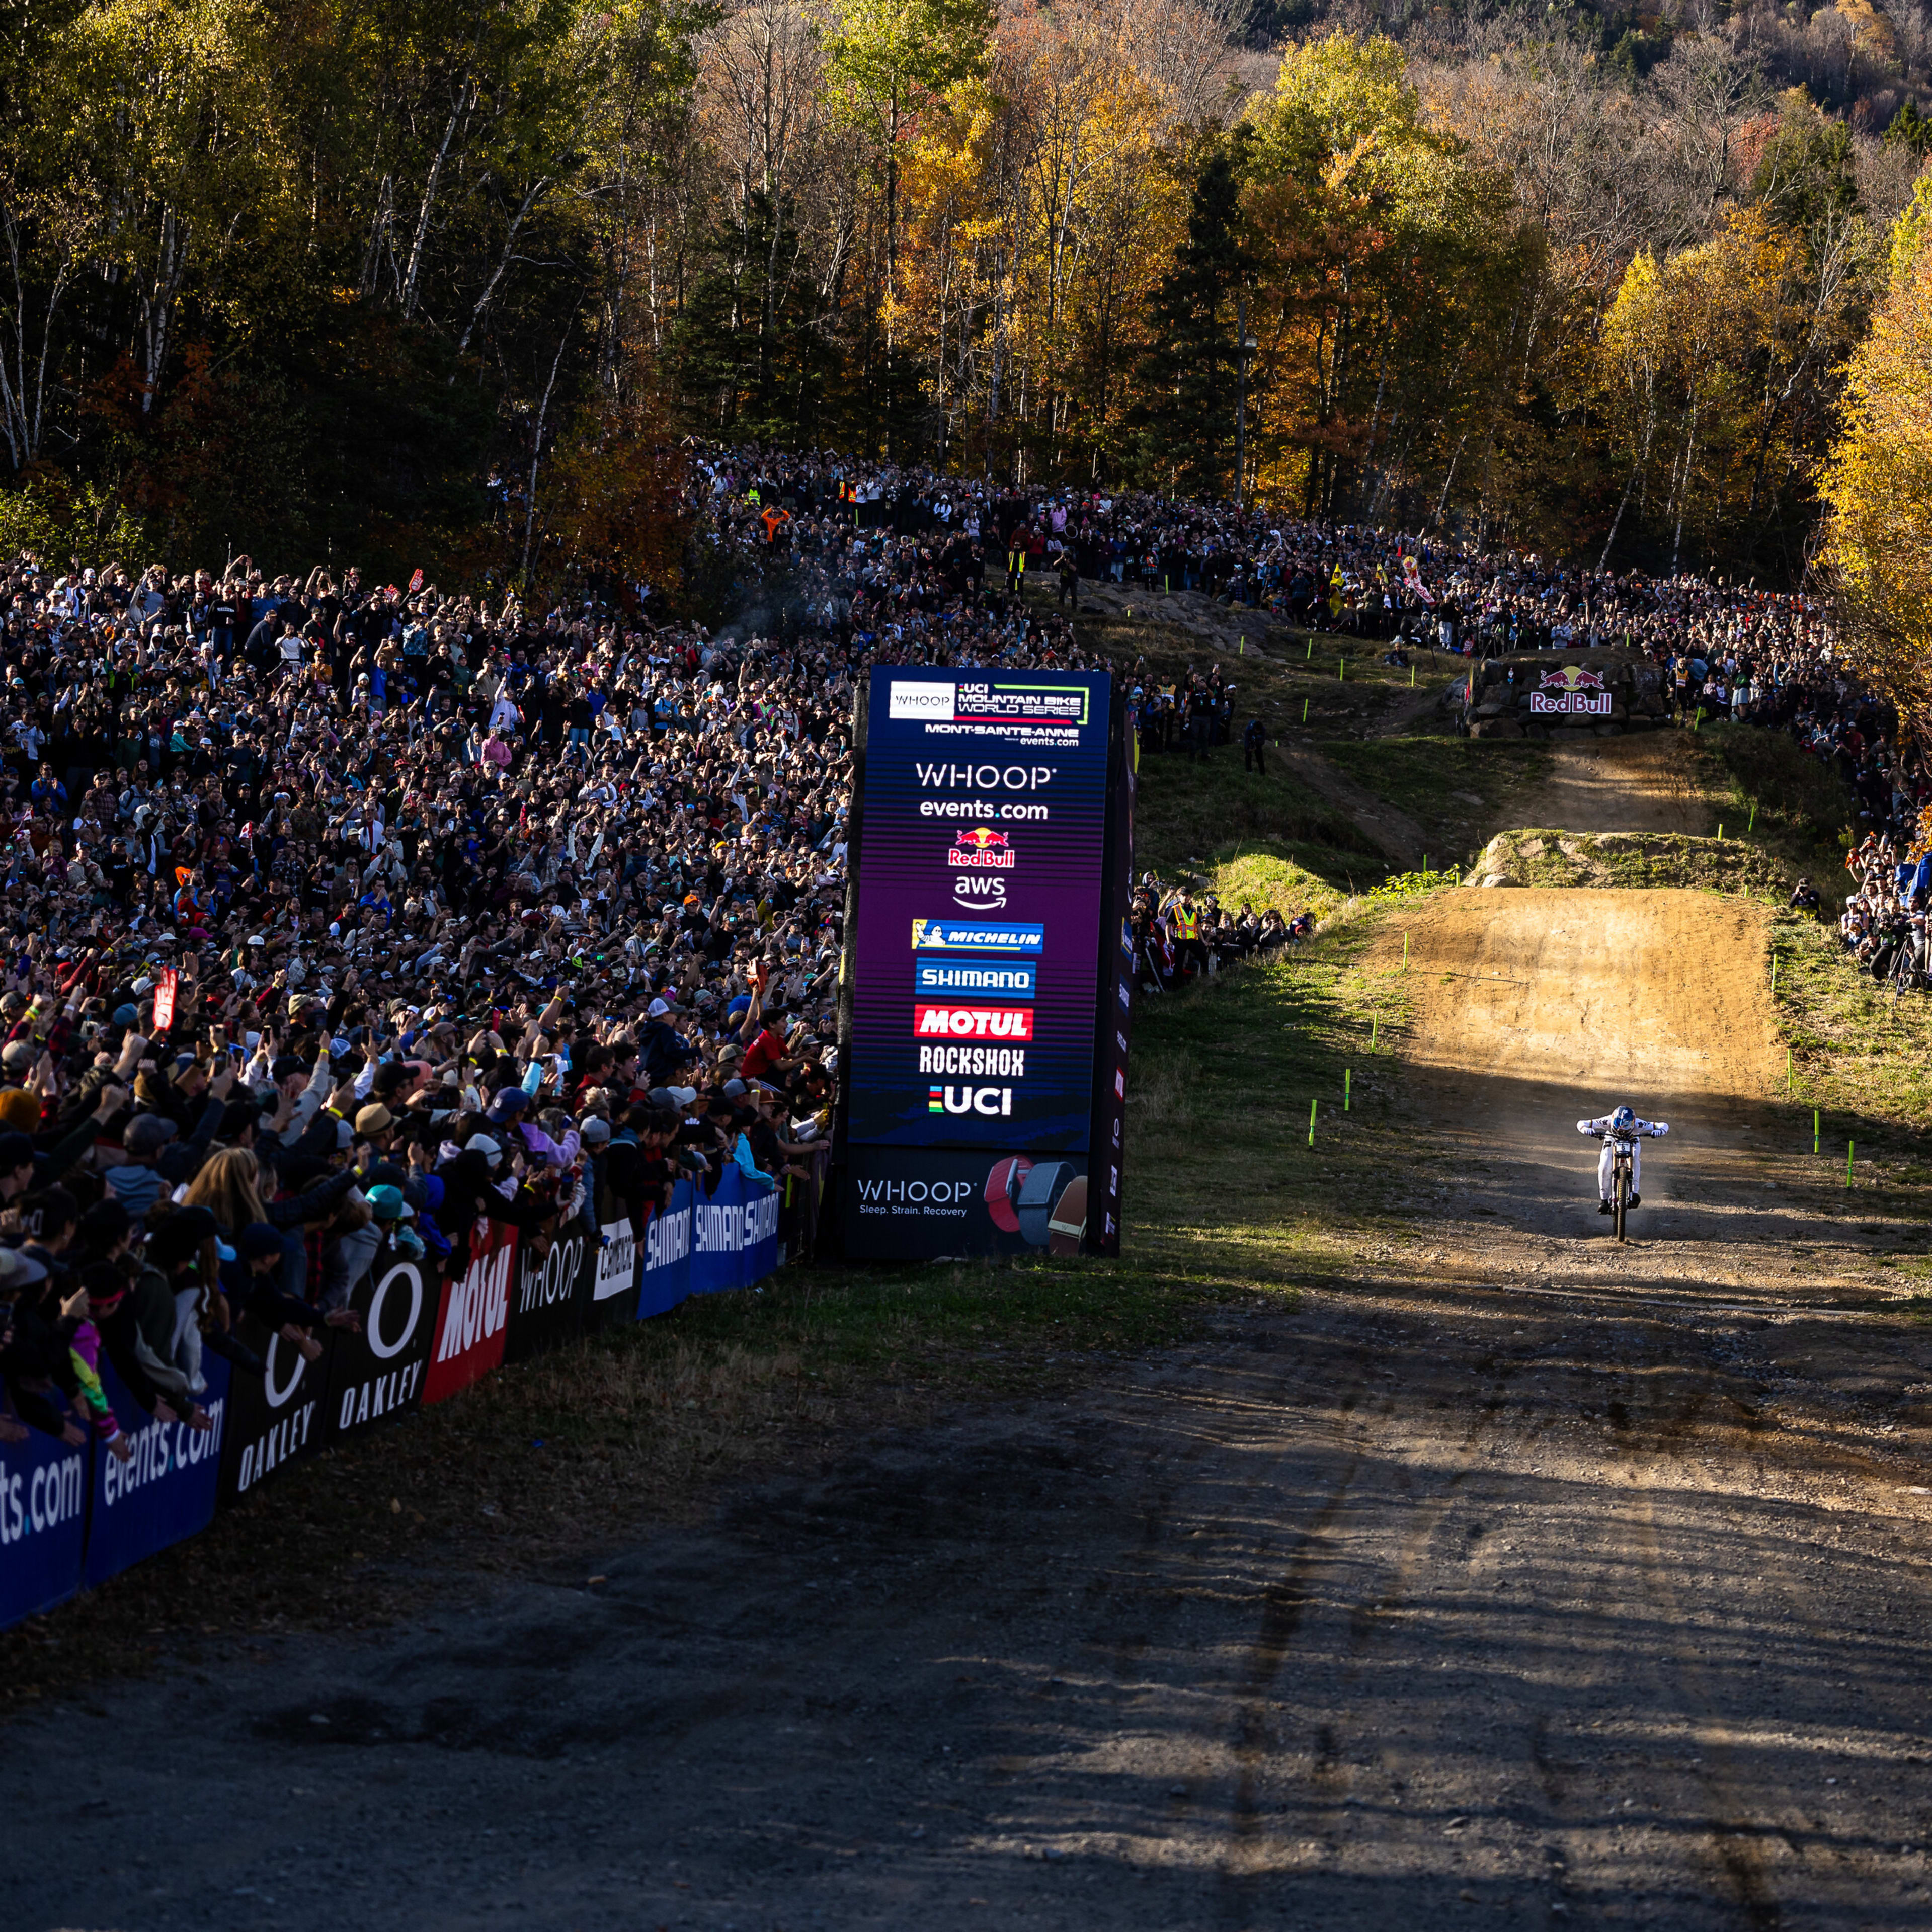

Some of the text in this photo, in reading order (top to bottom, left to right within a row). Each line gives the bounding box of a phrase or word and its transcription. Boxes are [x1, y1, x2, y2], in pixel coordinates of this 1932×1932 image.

[964, 683, 988, 693] UCI
[896, 696, 949, 706] WHOOP
[958, 694, 1081, 706] MOUNTAIN BIKE
[958, 703, 1080, 715] WORLD SERIES
[1531, 692, 1612, 714] Red Bull
[925, 725, 1079, 737] MONT-SAINTE-ANNE
[1020, 737, 1078, 746] events.com
[916, 763, 1051, 790] WHOOP
[920, 800, 1048, 820] events.com
[949, 849, 1015, 868] Red Bull
[955, 876, 1005, 895] aws
[947, 932, 1041, 944] MICHELIN
[922, 969, 1029, 988] SHIMANO
[920, 1010, 1027, 1036] MOTUL
[920, 1046, 1024, 1076] ROCKSHOX
[945, 1086, 1012, 1115] UCI
[858, 1180, 971, 1202] WHOOP
[744, 1191, 779, 1246] SHIMANO
[860, 1205, 967, 1217] Sleep. Strain. Recovery
[695, 1204, 744, 1252] SHIMANO
[519, 1236, 583, 1313] WHOOP
[339, 1360, 423, 1430] OAKLEY
[238, 1400, 316, 1492] OAKLEY
